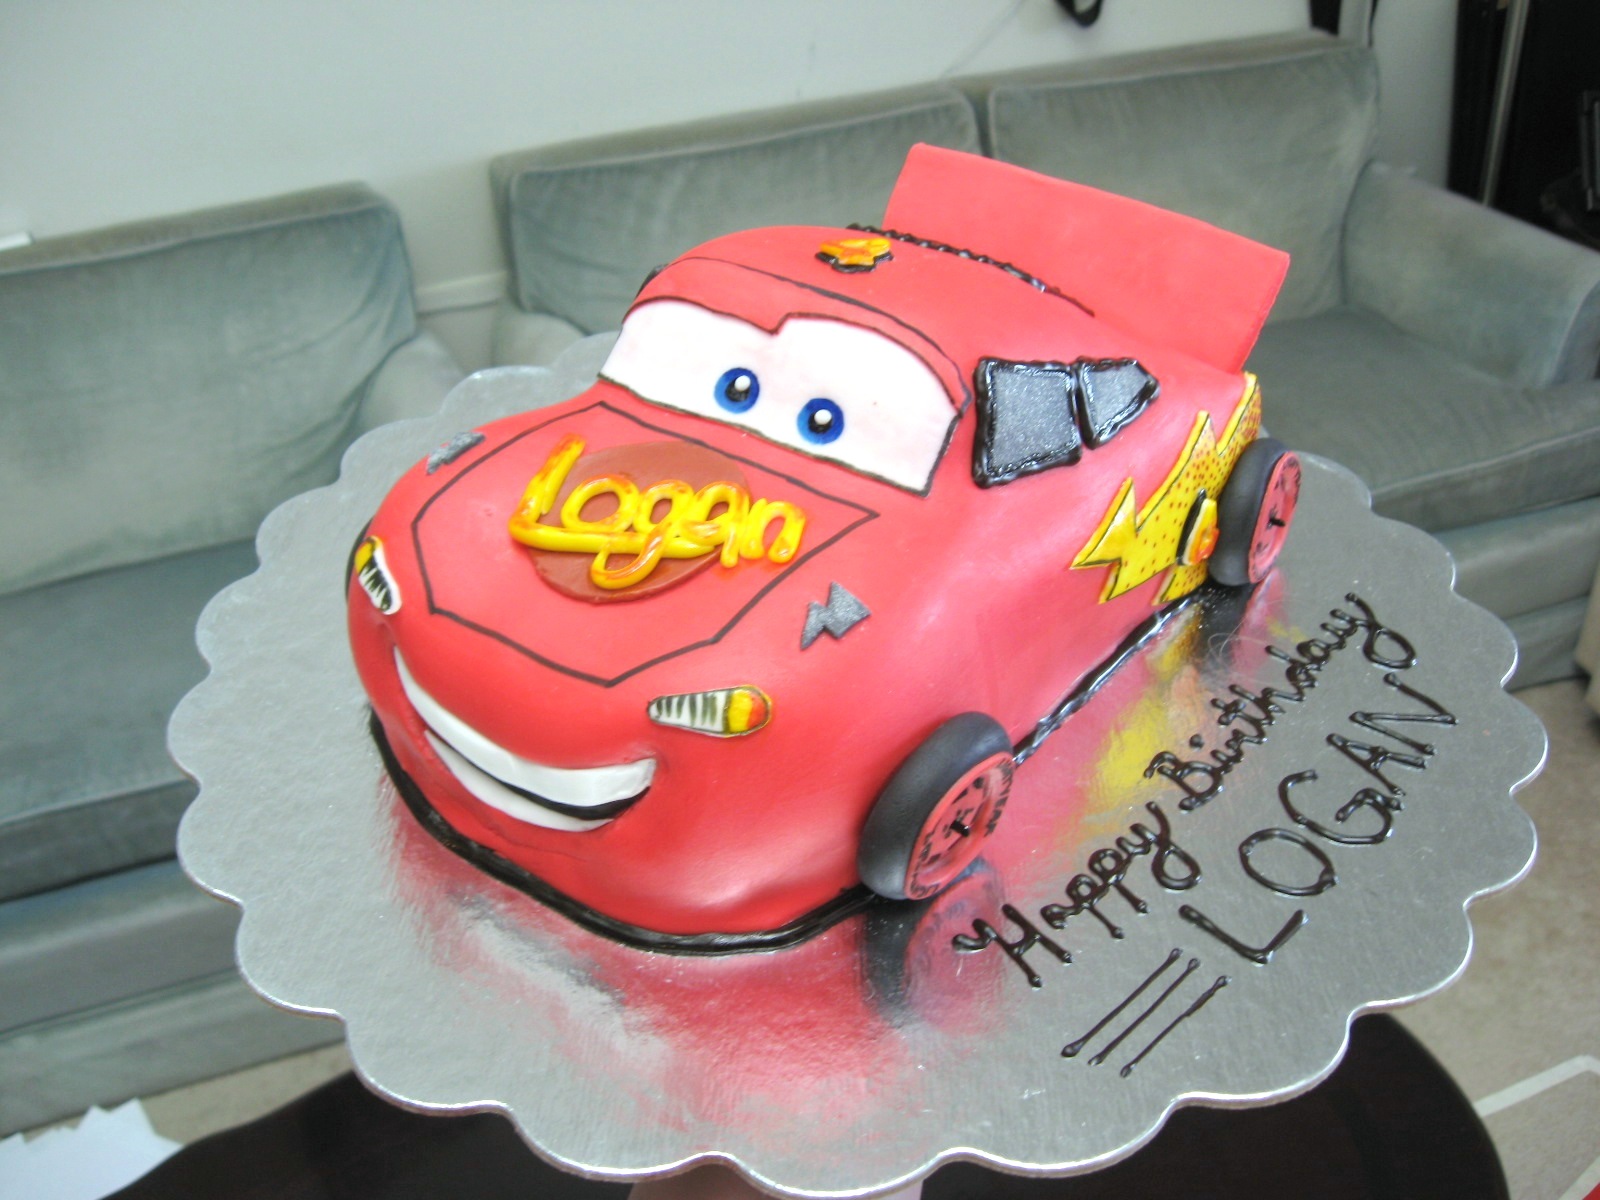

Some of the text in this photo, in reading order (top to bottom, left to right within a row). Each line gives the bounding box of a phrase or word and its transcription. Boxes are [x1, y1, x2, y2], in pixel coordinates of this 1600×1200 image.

[508, 432, 806, 590] Logan
[951, 592, 1417, 988] Happy Birthday
[1178, 672, 1459, 965] LOGAN
